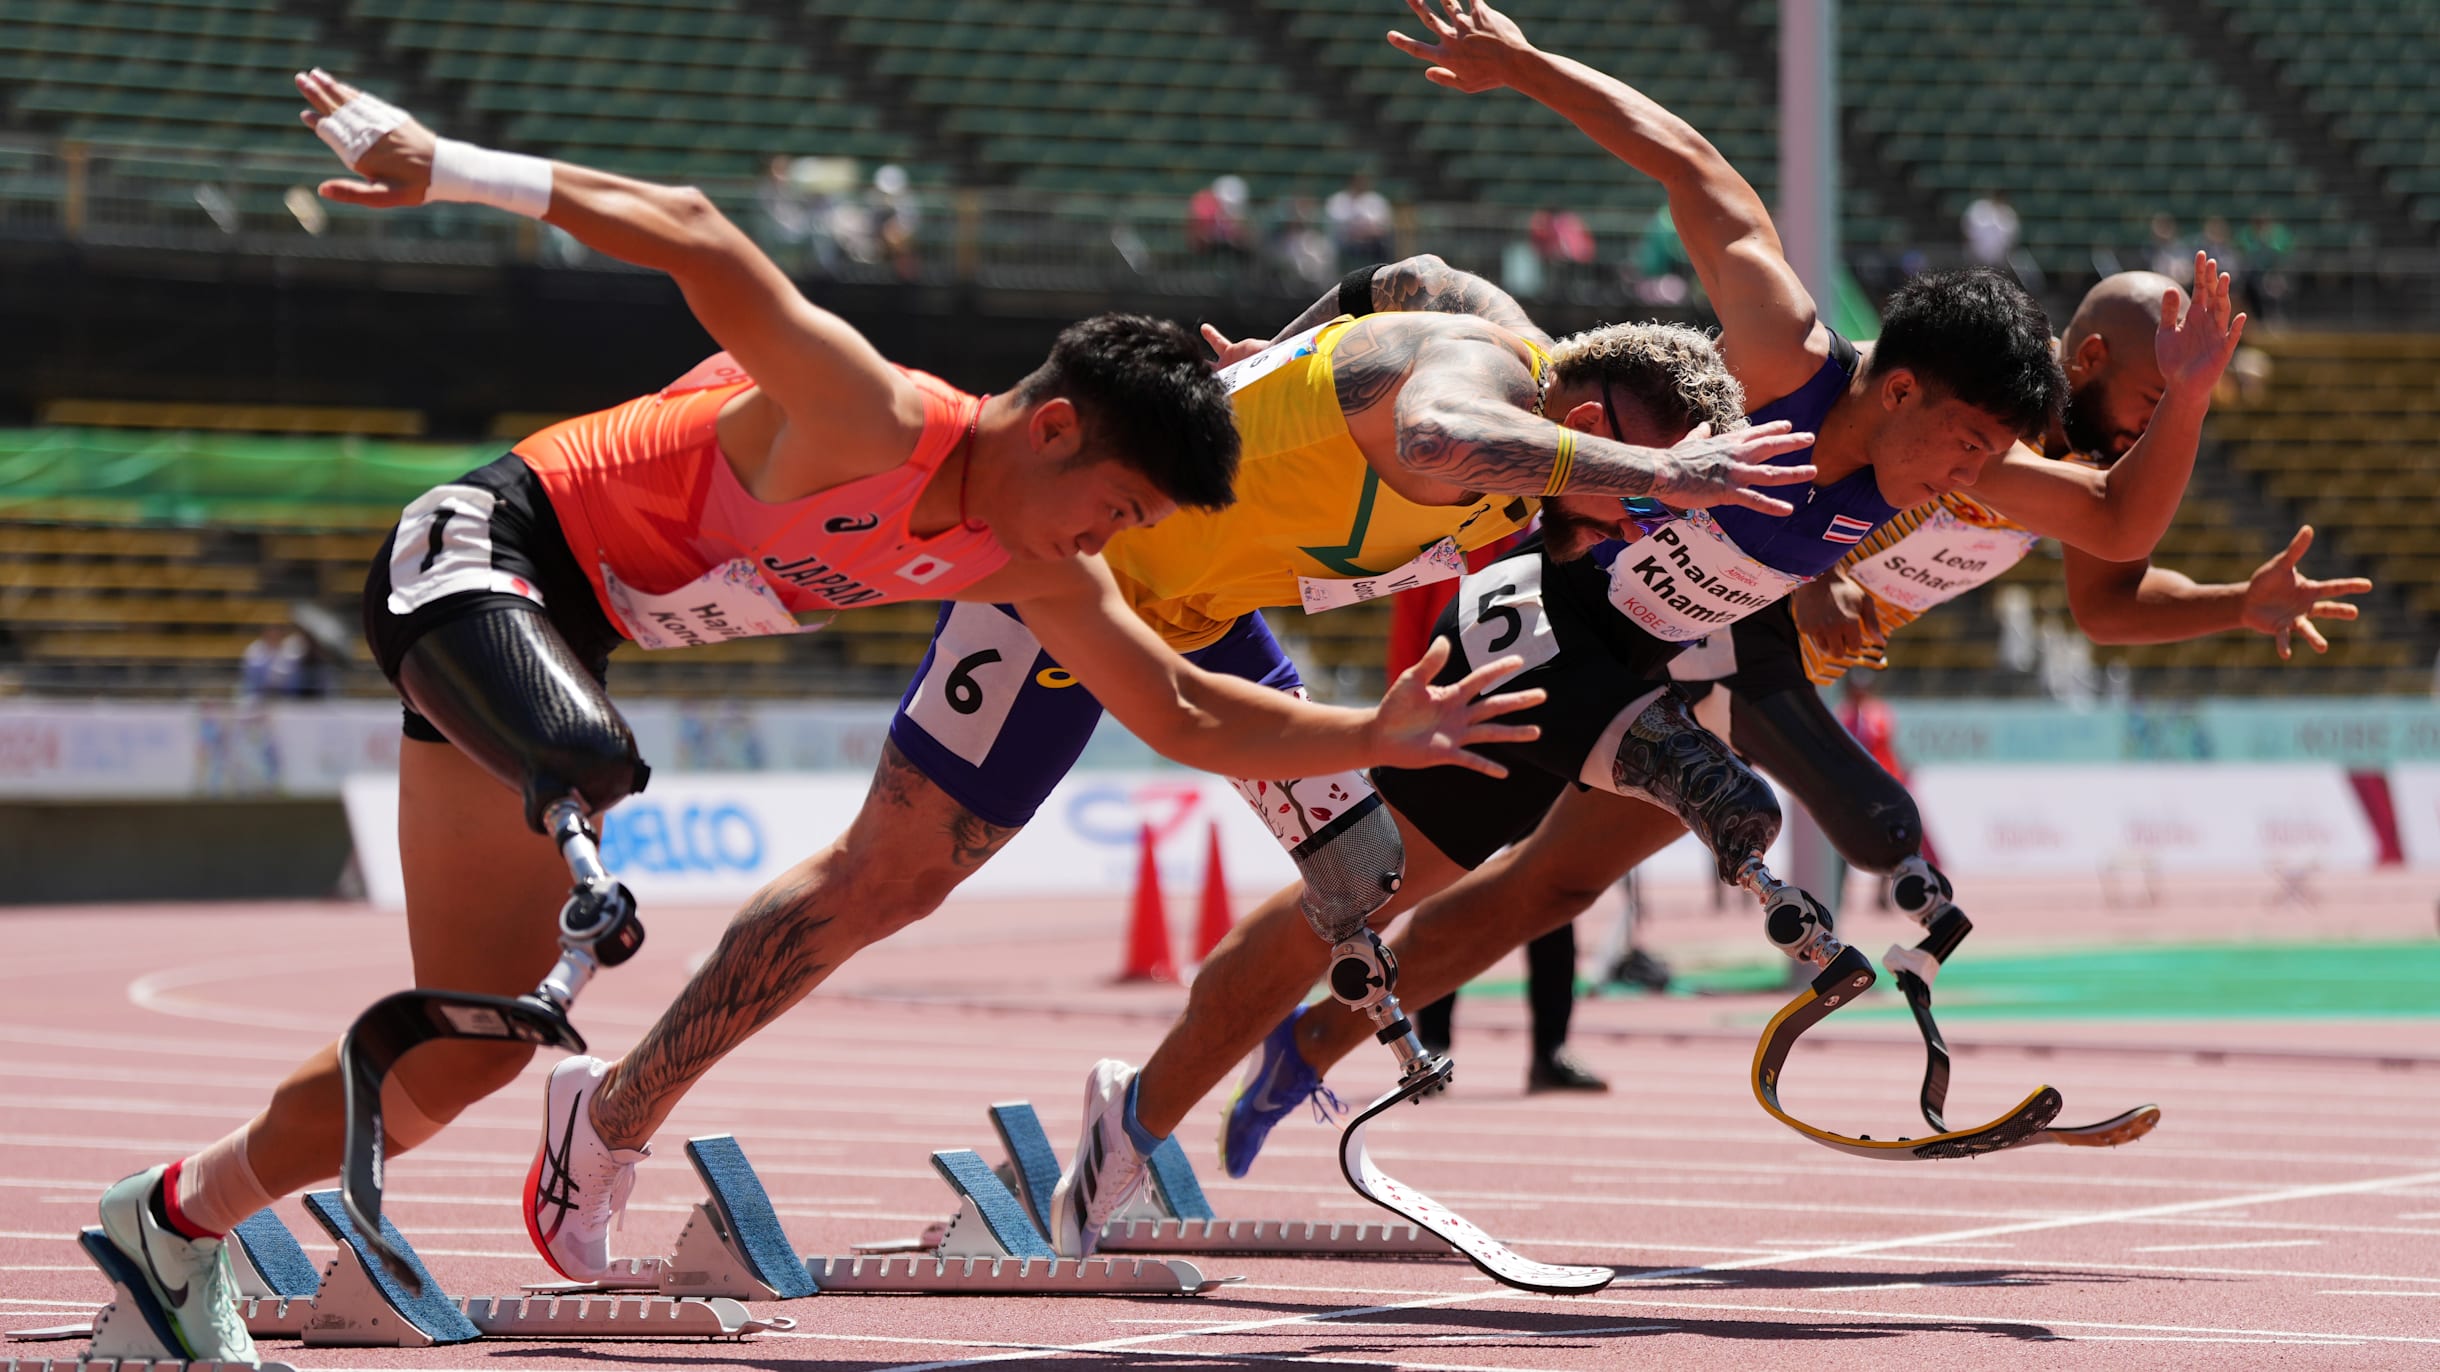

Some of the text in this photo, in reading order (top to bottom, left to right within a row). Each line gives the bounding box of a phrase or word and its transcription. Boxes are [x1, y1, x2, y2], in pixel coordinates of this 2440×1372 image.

[763, 555, 883, 606] JAPAN
[1932, 548, 1987, 572] Leon
[1478, 584, 1522, 653] 5
[1623, 597, 1667, 630] KOBE
[945, 648, 1002, 715] 6
